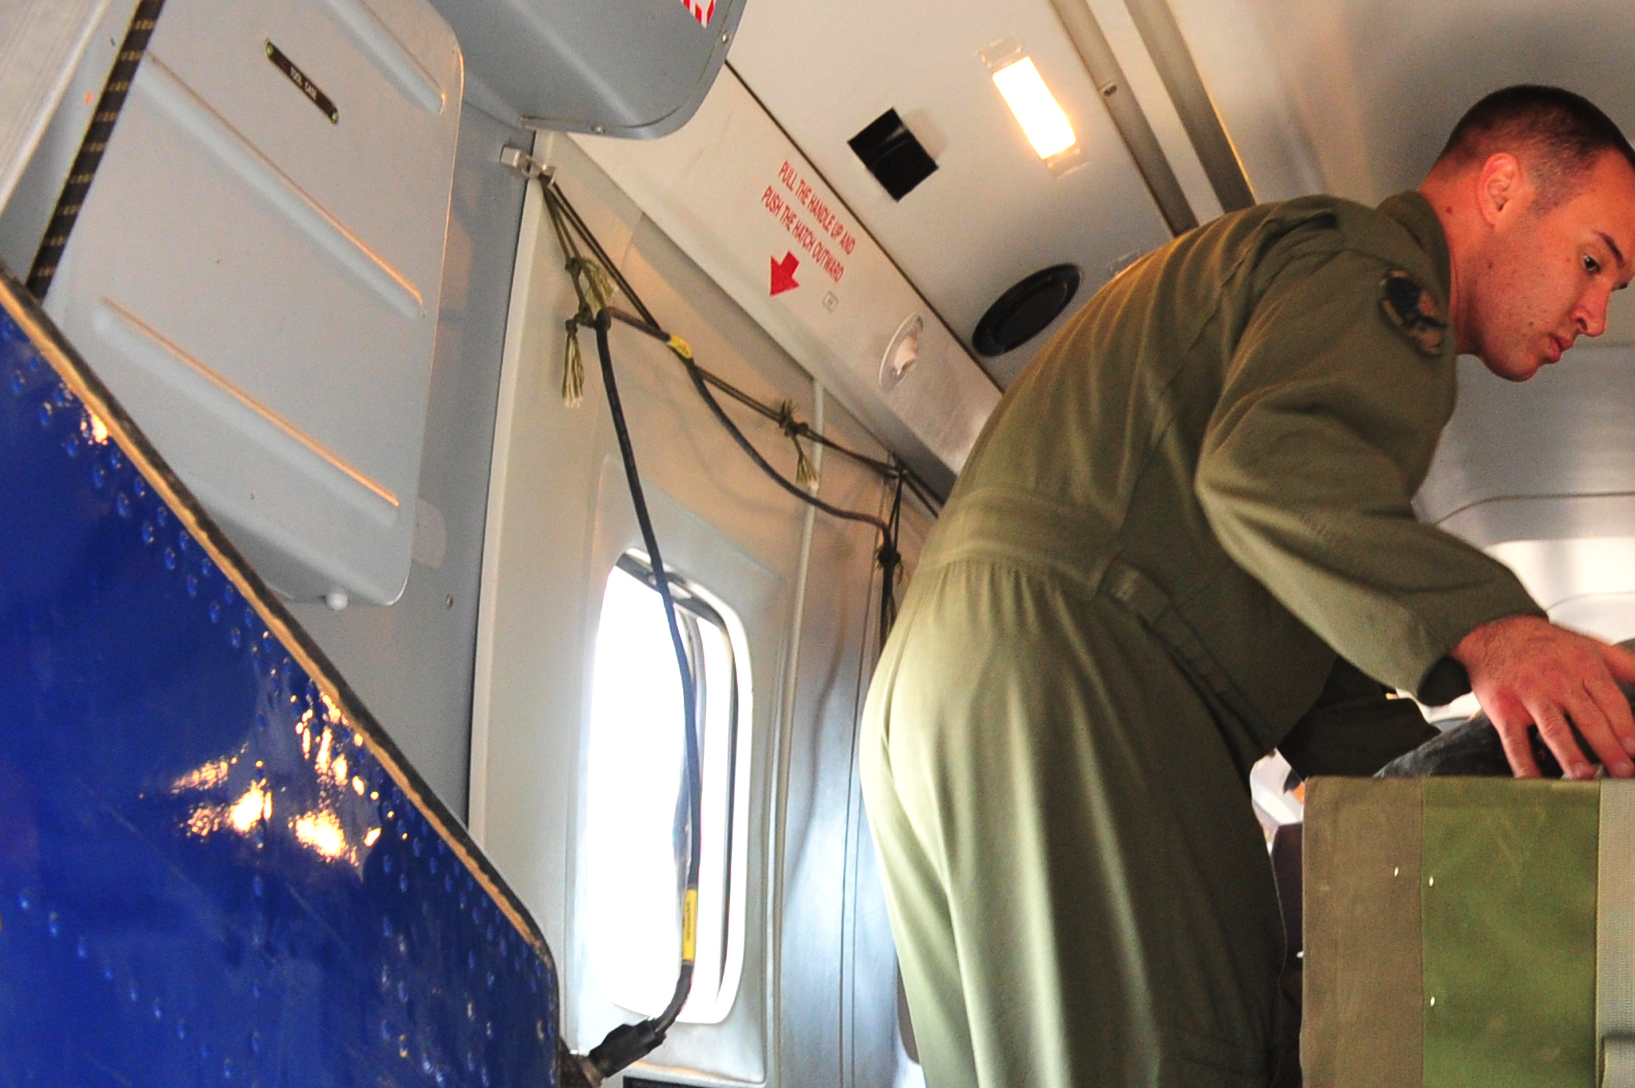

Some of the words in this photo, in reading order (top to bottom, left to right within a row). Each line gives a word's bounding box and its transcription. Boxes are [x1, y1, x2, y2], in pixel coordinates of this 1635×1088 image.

[761, 185, 784, 217] PUSH
[780, 204, 798, 232] THE
[792, 220, 817, 253] HATCH
[812, 241, 845, 283] OUTWARD
[778, 160, 798, 192] PULL
[794, 178, 812, 206] THE
[807, 193, 835, 232] HANDLE
[830, 220, 845, 239] UP
[839, 231, 856, 255] AND
